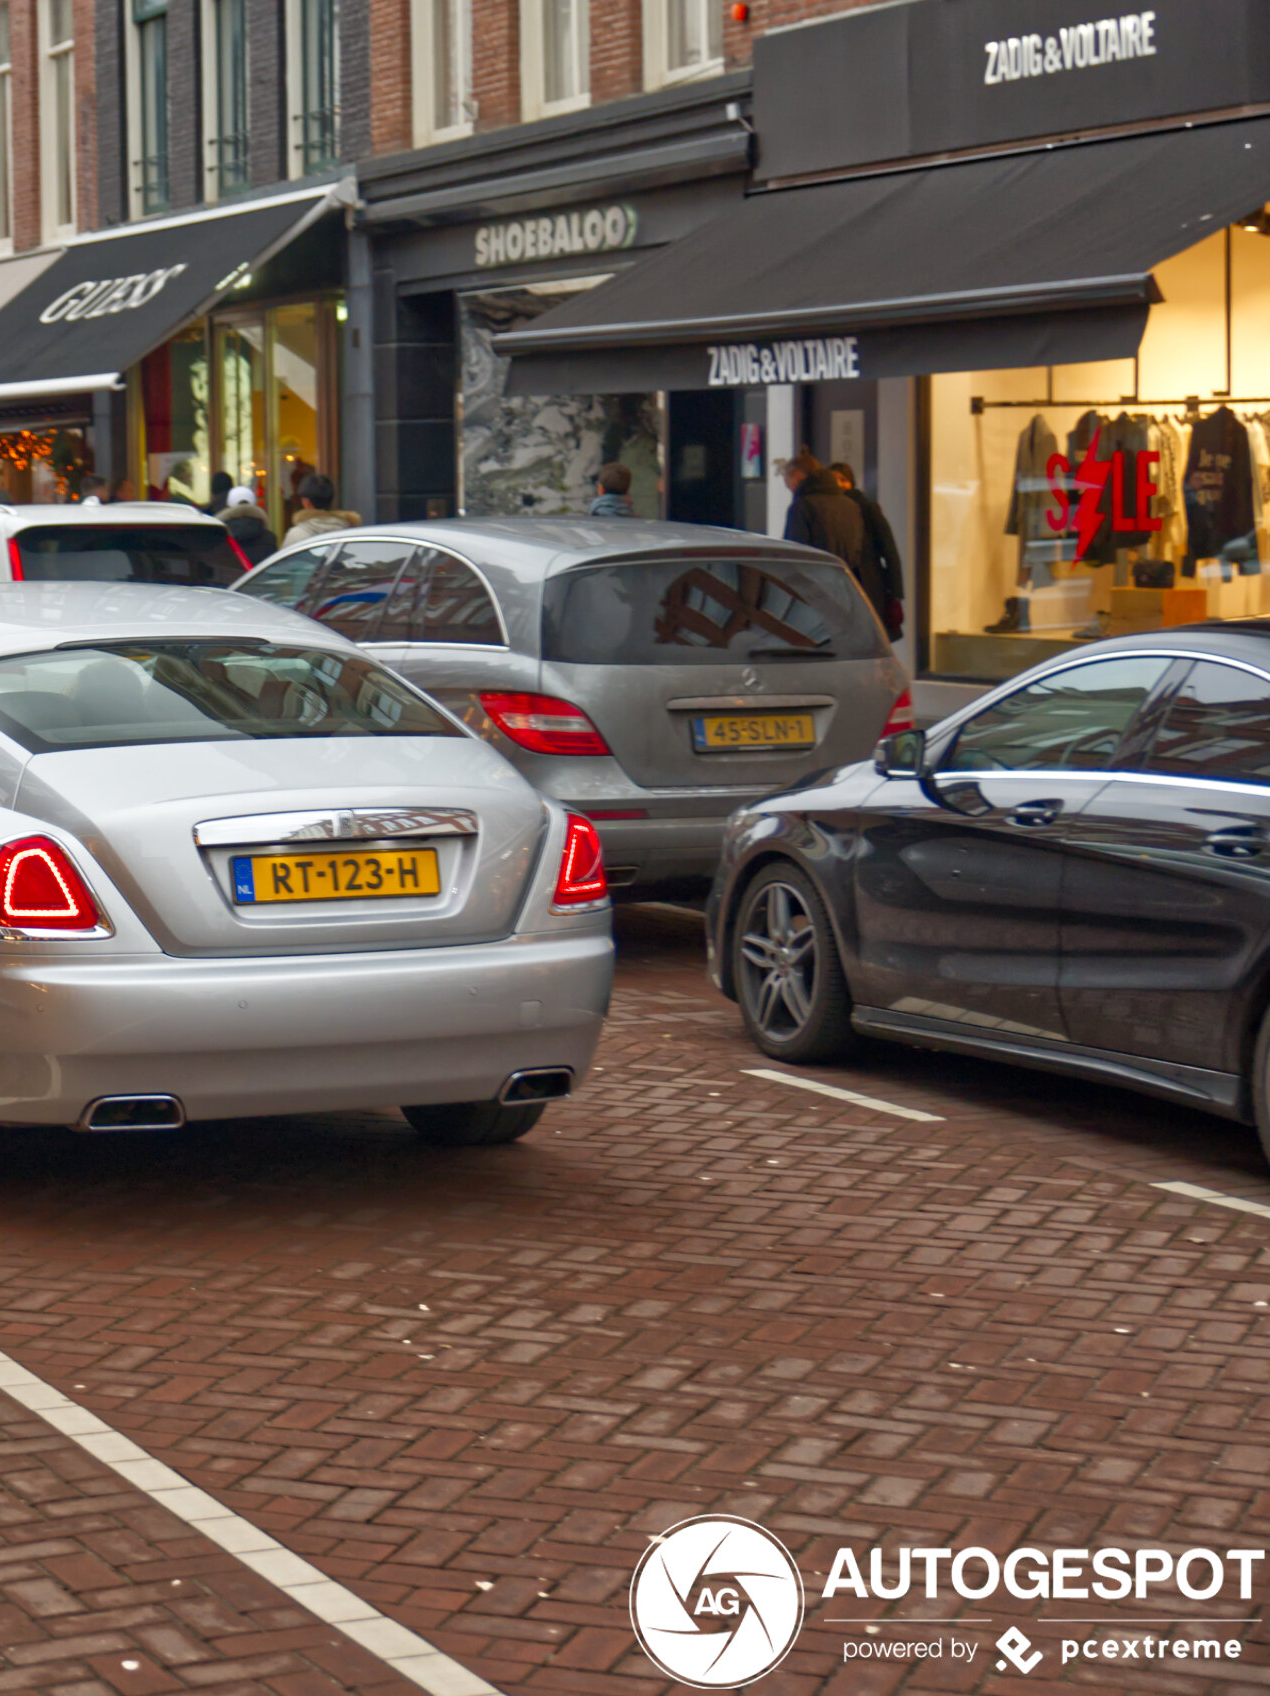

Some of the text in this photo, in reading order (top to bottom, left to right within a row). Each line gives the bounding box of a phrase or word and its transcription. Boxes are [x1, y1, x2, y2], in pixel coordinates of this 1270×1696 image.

[984, 11, 1156, 85] ZADIG&VOLTAIRE
[475, 205, 629, 266] SHOEBALOO
[39, 263, 188, 323] GUESS
[707, 337, 860, 386] ZADIG&VOLTAIRE
[714, 719, 804, 741] 45-SLN-1
[237, 884, 253, 895] NL
[271, 857, 419, 894] RT-123-H
